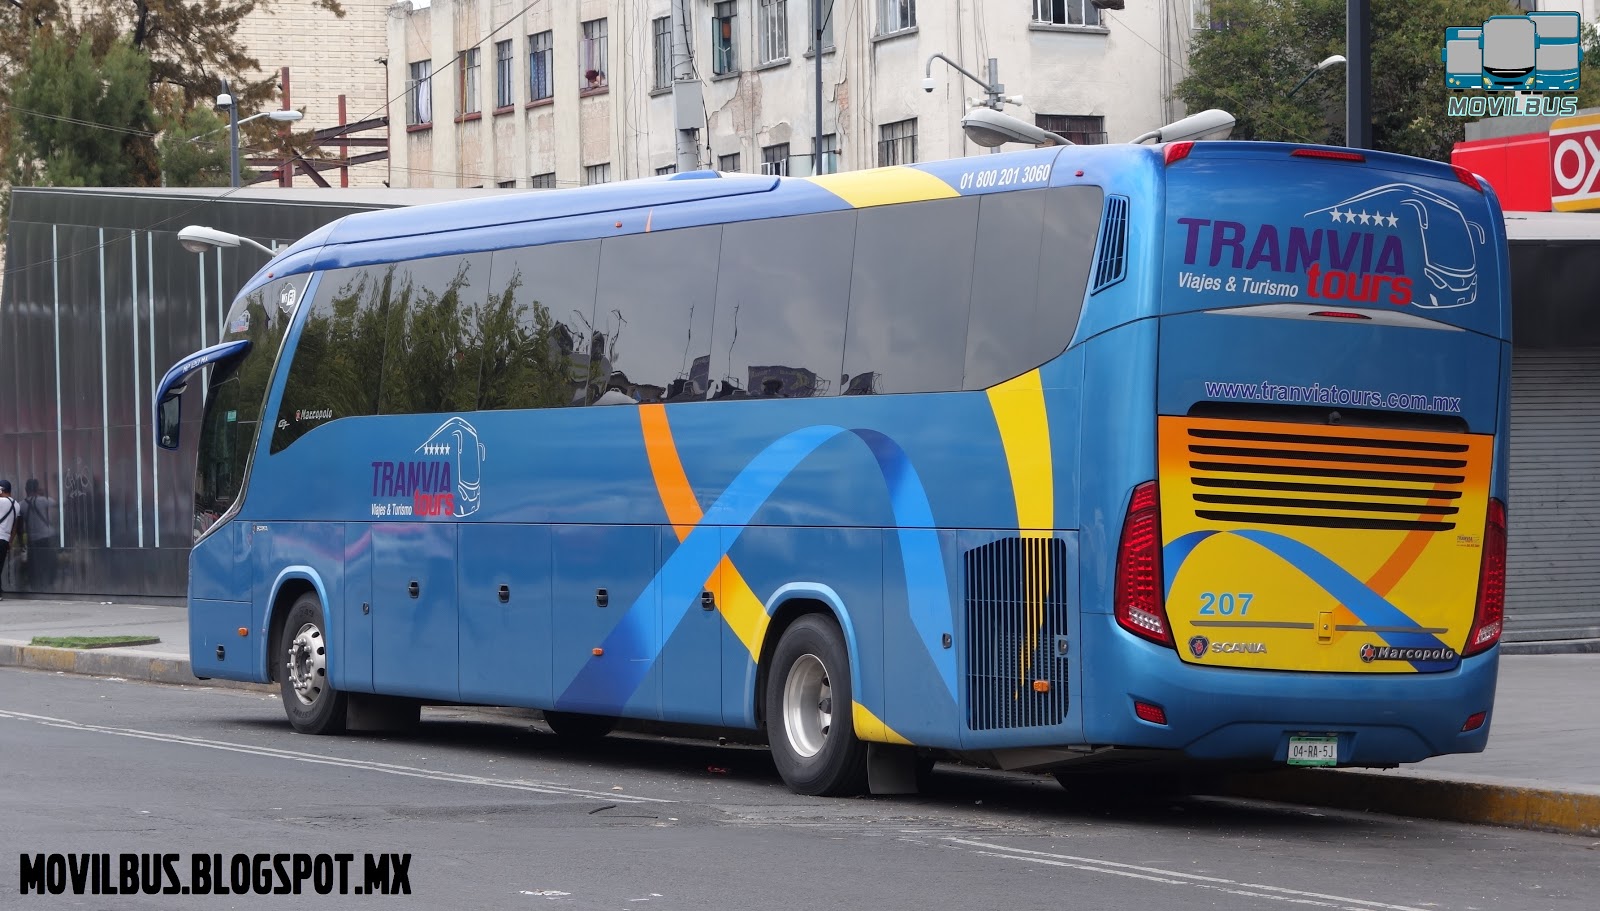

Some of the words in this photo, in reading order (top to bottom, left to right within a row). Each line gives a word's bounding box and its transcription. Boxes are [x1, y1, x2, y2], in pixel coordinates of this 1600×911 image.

[960, 172, 975, 190] 01
[976, 169, 998, 188] 800
[998, 167, 1020, 186] 201
[1021, 163, 1051, 183] 3060
[1177, 217, 1406, 276] TRANVIA
[1179, 272, 1221, 292] Viajes
[1225, 276, 1237, 292] &
[1242, 277, 1299, 297] Turismo
[1306, 260, 1414, 306] tours
[1205, 380, 1461, 413] www.tranviatours.com.mx
[300, 408, 333, 420] Marcopolo
[371, 461, 451, 497] TRANVIA
[371, 503, 386, 518] Viajes
[392, 503, 413, 516] Turismo
[413, 488, 455, 517] tours
[1199, 592, 1254, 616] 207
[1211, 641, 1267, 654] SCANIA
[1378, 646, 1454, 661] Marcopolo
[1293, 745, 1334, 758] 04-RA-5J
